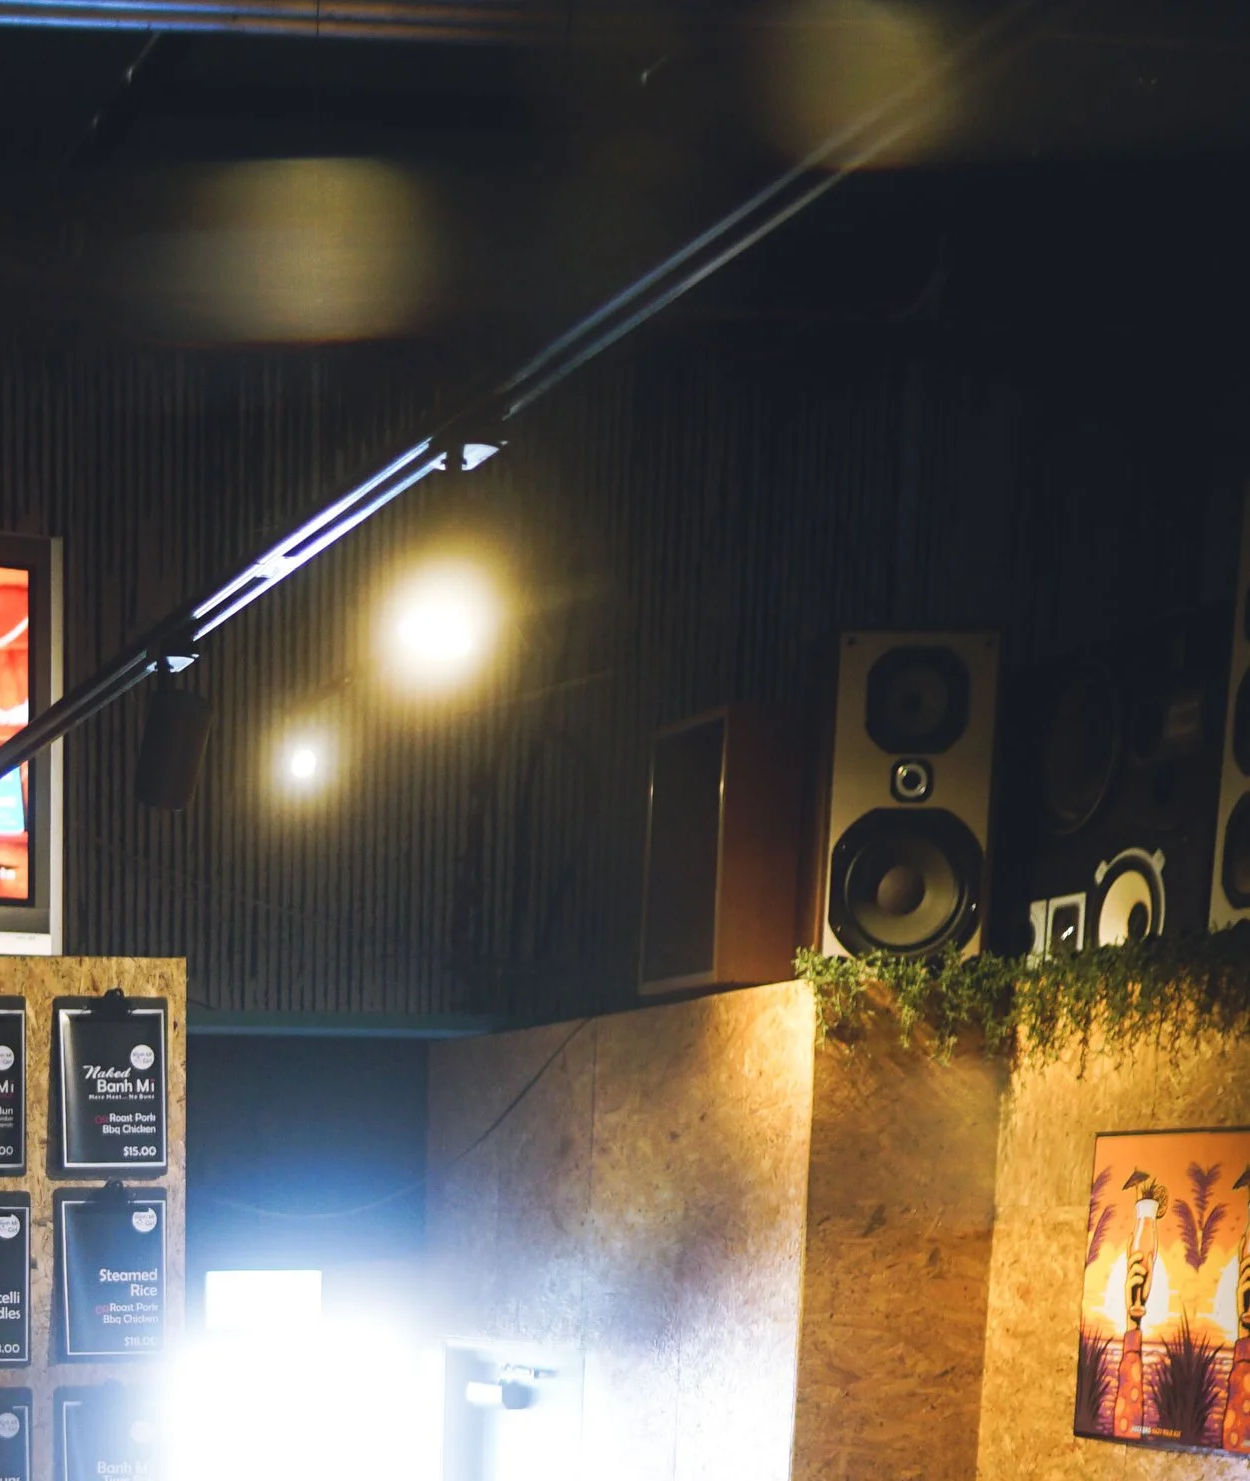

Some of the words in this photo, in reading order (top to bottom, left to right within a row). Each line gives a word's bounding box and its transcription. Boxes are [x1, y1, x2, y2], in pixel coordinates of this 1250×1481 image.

[83, 1065, 131, 1079] Naked
[97, 1079, 132, 1093] Banh
[110, 1113, 133, 1123] Roast
[135, 1112, 156, 1122] Pork
[103, 1124, 121, 1135] Bbq
[123, 1124, 156, 1134] Chicken
[123, 1146, 157, 1157] $15.00
[99, 1268, 158, 1282] Steamed
[130, 1284, 158, 1297] Rice
[110, 1303, 134, 1312] Roast
[136, 1303, 158, 1312] Pork
[103, 1314, 121, 1325] Bbq
[123, 1314, 159, 1323] Chicken
[97, 1460, 132, 1474] Banh
